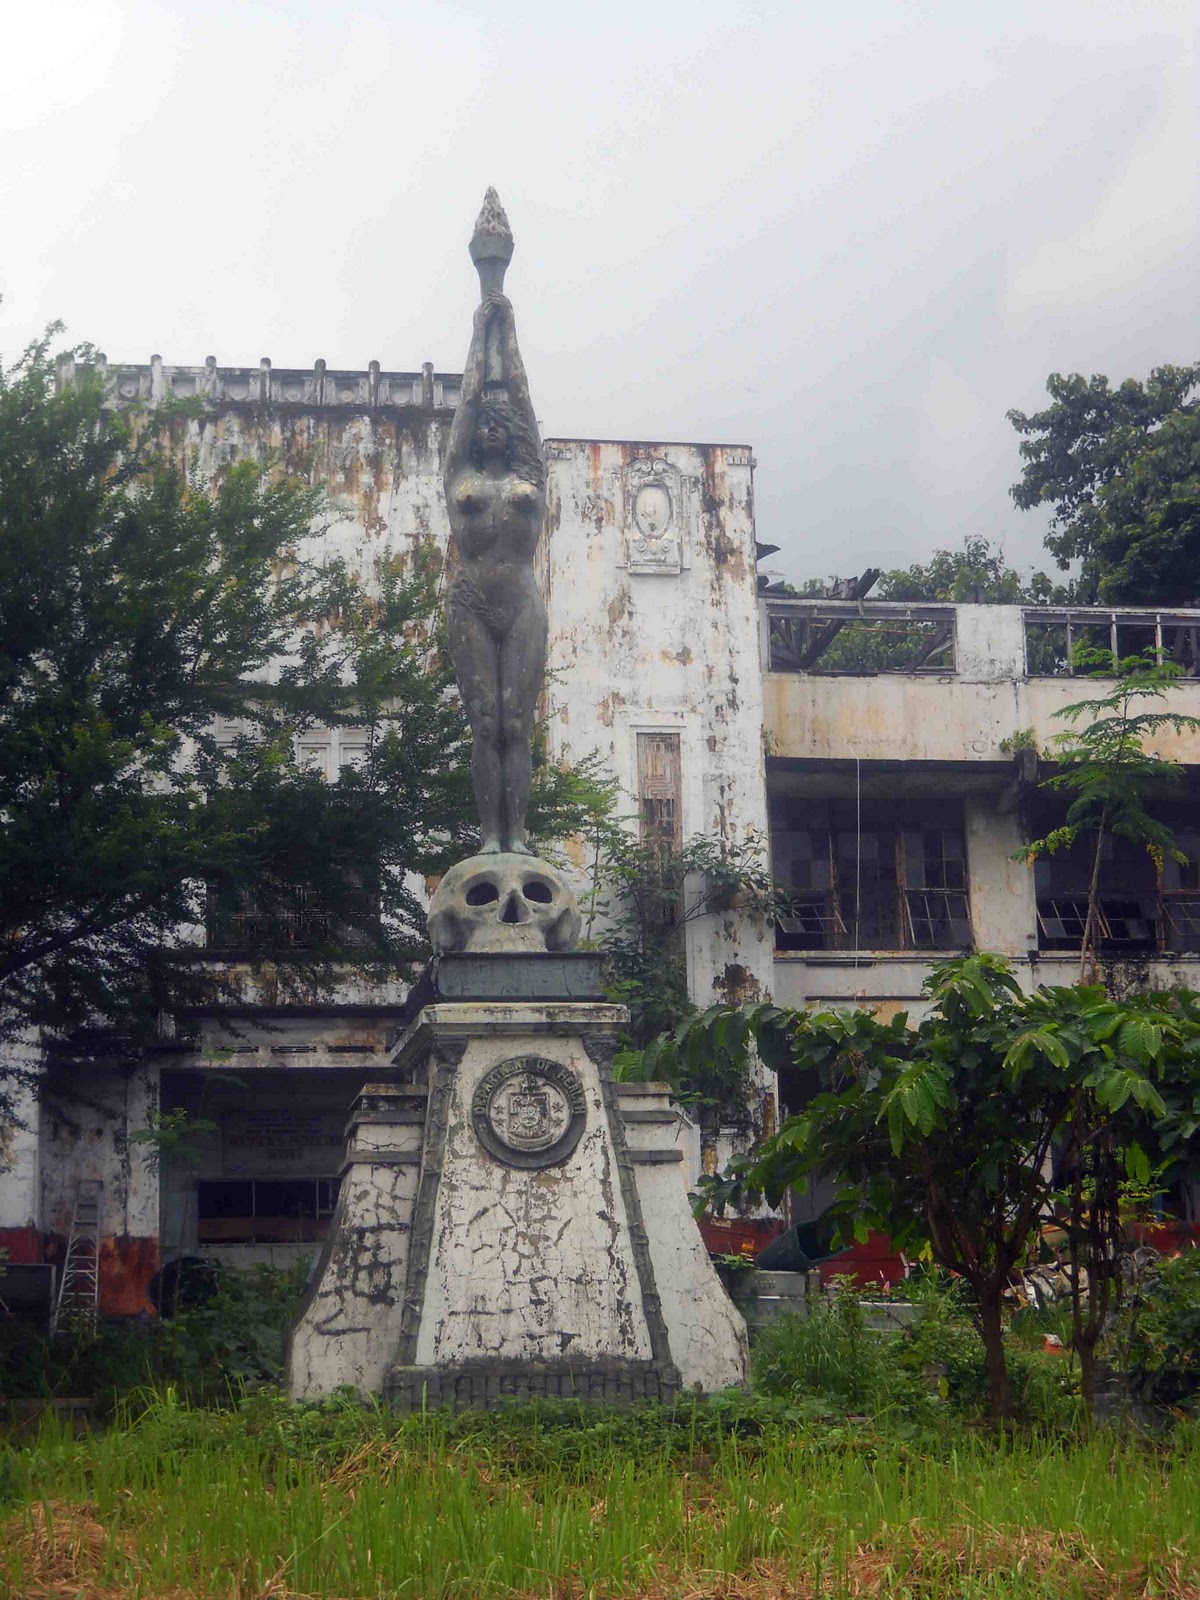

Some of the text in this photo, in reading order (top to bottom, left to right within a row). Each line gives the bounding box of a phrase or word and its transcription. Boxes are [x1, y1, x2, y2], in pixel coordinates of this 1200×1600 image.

[474, 1058, 586, 1115] DEPARTMENT OF HEALTH
